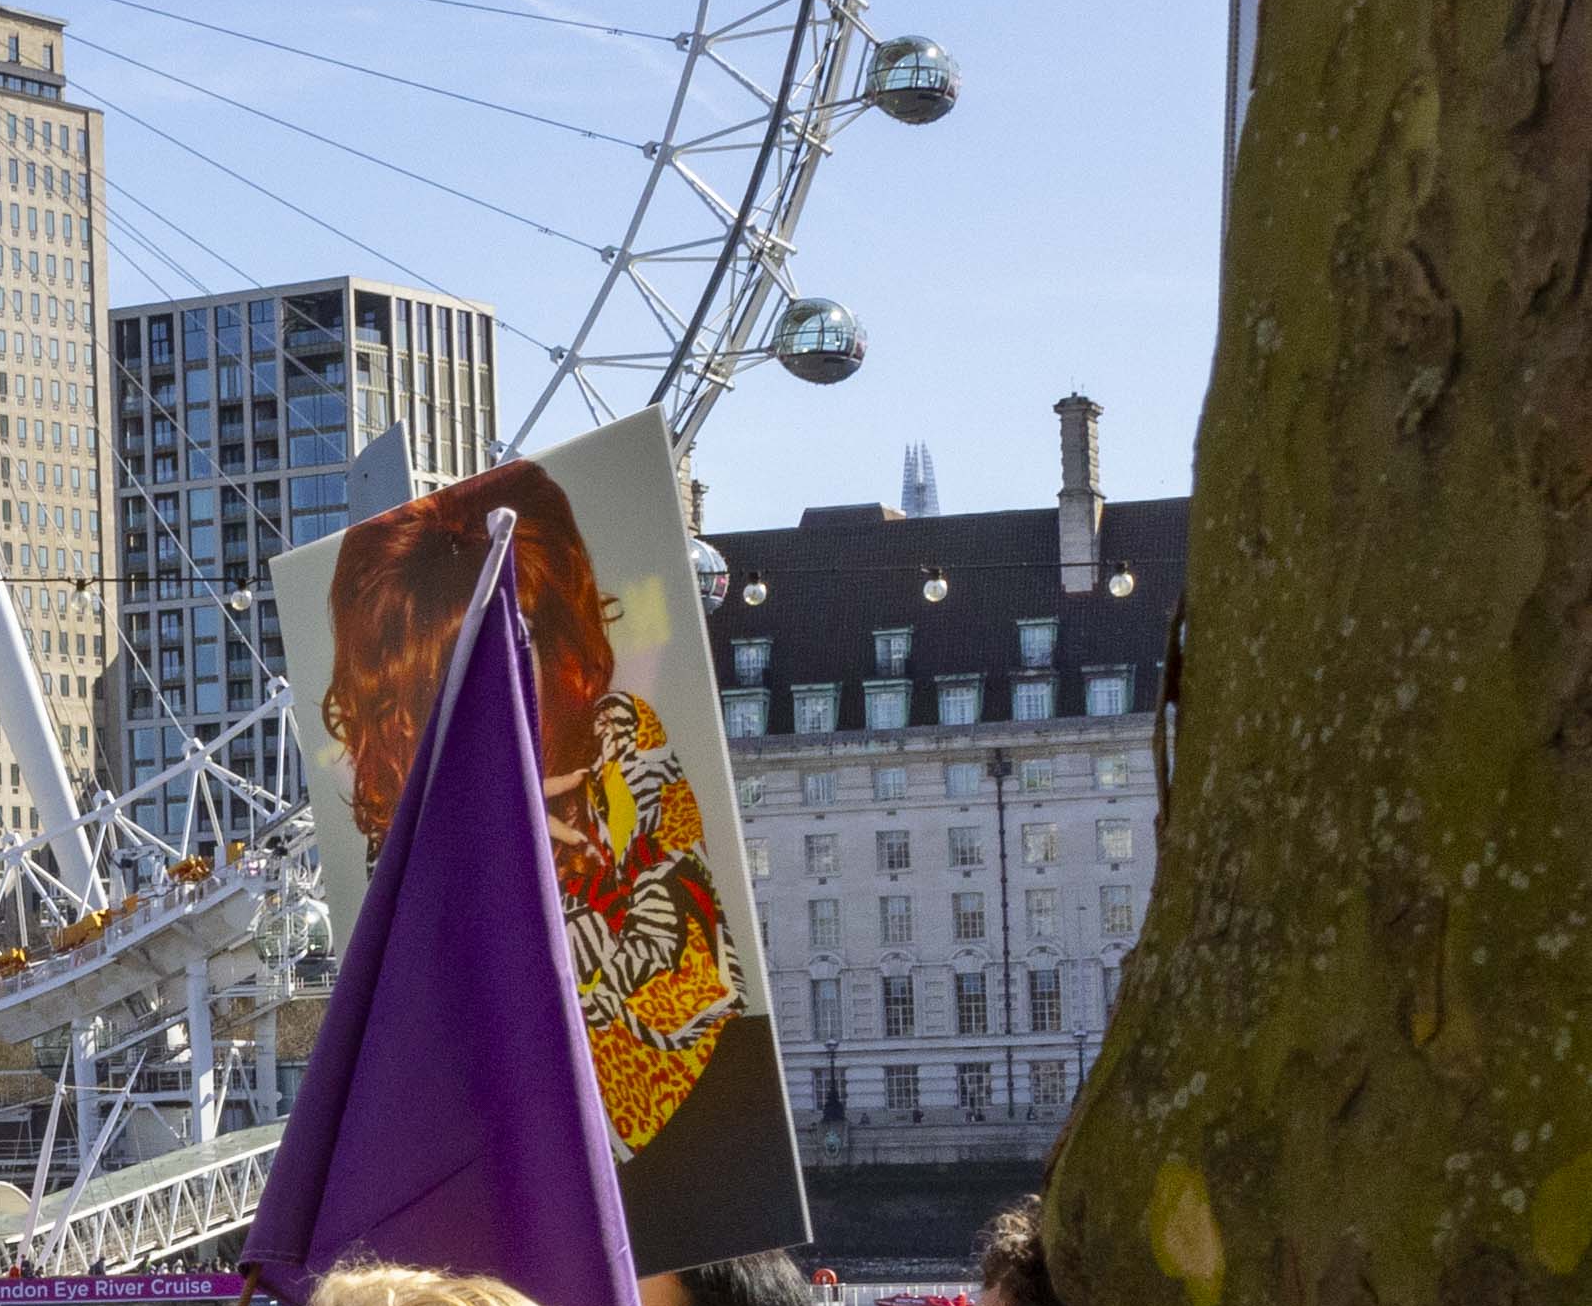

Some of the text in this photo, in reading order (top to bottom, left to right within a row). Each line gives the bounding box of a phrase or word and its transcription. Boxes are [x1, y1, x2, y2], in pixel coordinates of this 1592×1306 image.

[54, 1279, 89, 1300] Eye
[96, 1276, 145, 1296] River
[151, 1275, 213, 1295] Cruise
